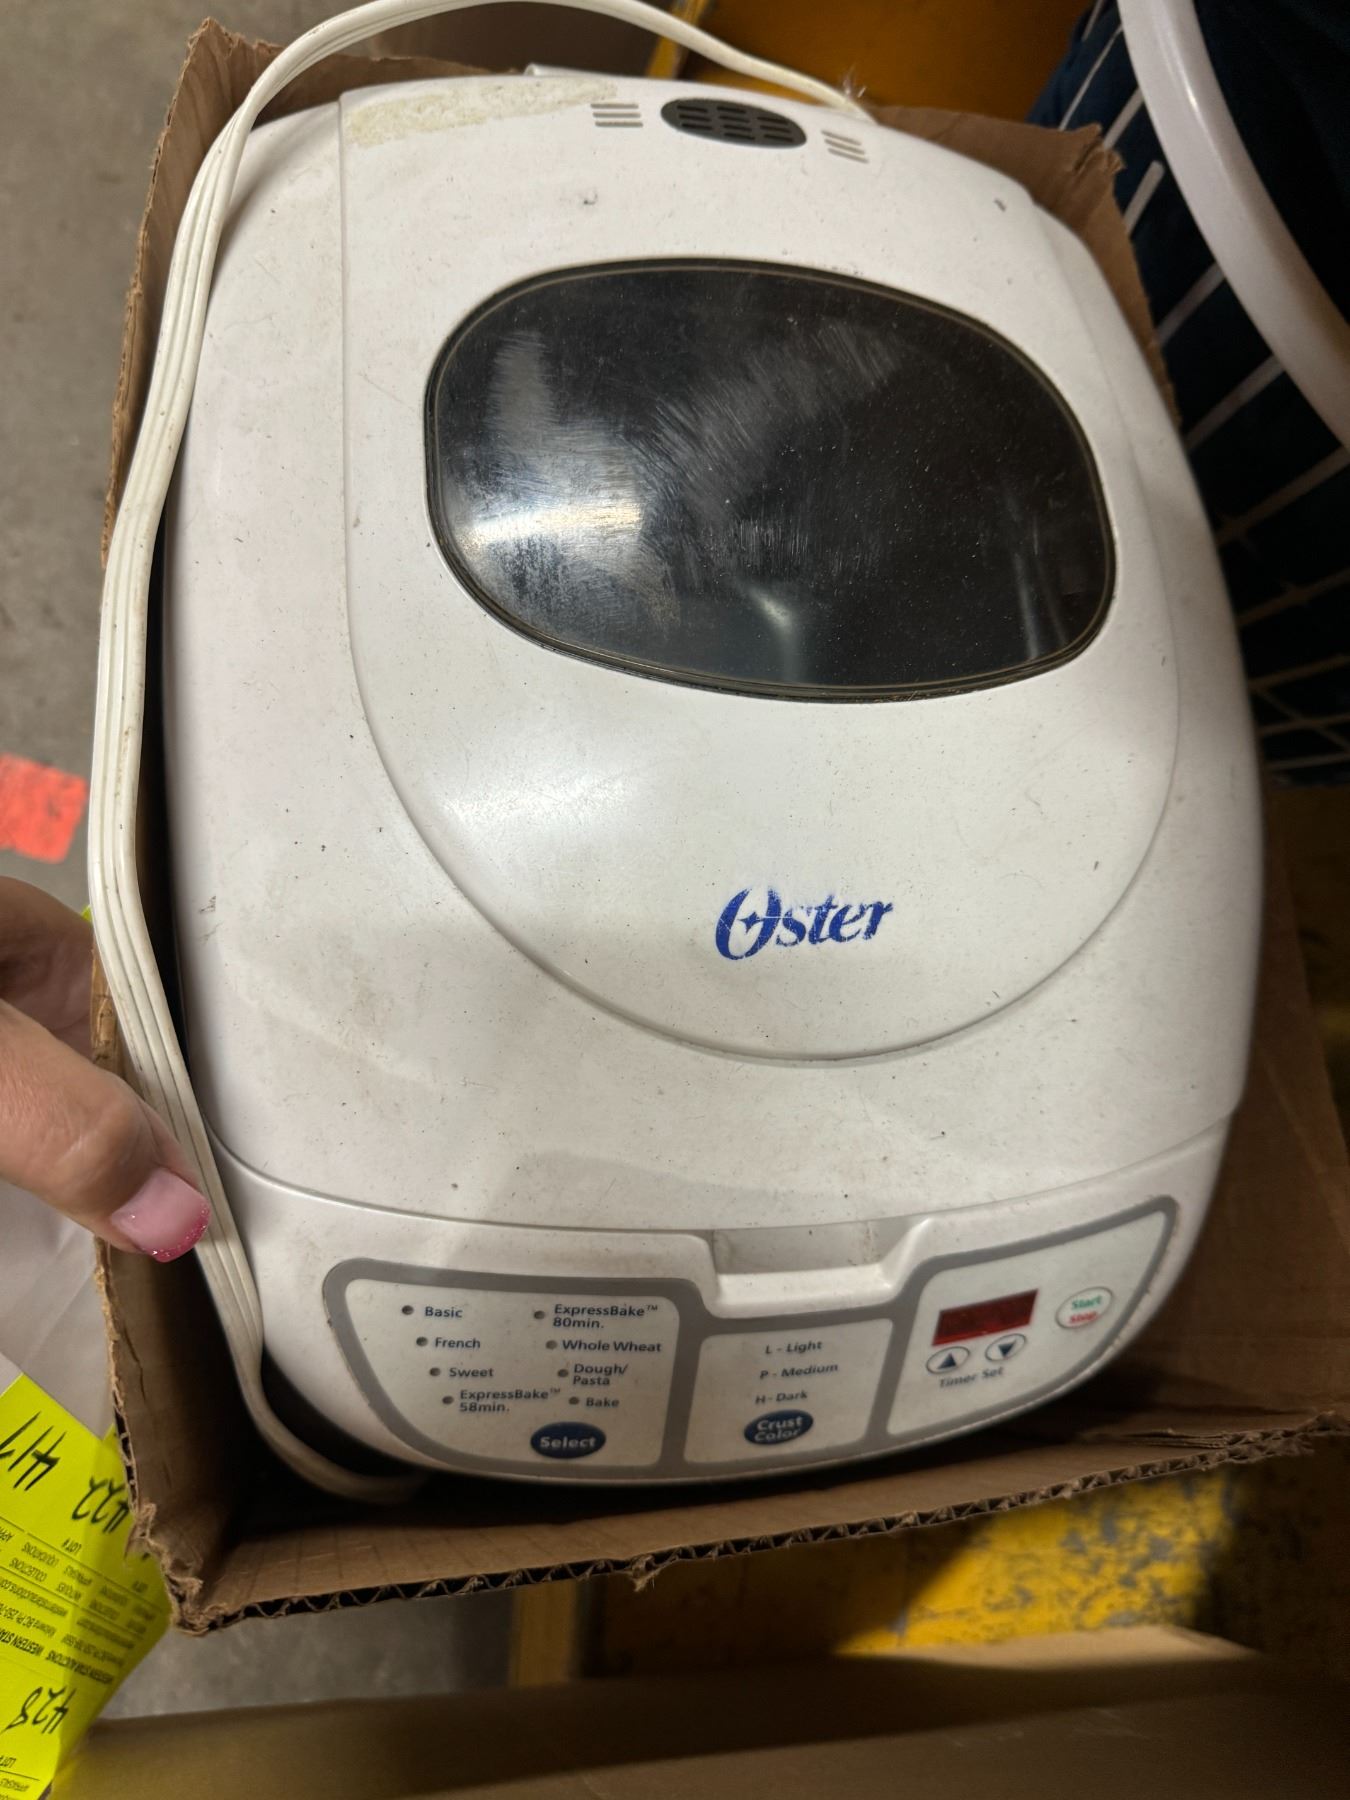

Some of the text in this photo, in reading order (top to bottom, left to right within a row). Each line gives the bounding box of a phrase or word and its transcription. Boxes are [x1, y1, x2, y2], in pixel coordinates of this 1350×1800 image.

[715, 886, 894, 960] Oster
[424, 1306, 463, 1319] Basic
[434, 1336, 481, 1349] French
[562, 1339, 662, 1353] Whole Wheat
[765, 1345, 772, 1354] L
[786, 1340, 823, 1354] Light
[448, 1367, 494, 1378] Sweet
[760, 1370, 769, 1379] P
[781, 1364, 839, 1377] Medium
[572, 1375, 611, 1387] Pasta
[585, 1396, 620, 1408] Bake
[755, 1395, 766, 1404] H
[776, 1390, 808, 1402] Dark
[757, 1416, 803, 1431] Crust
[539, 1435, 597, 1449] Select
[754, 1428, 800, 1442] Color
[0, 1686, 77, 1735] 428
